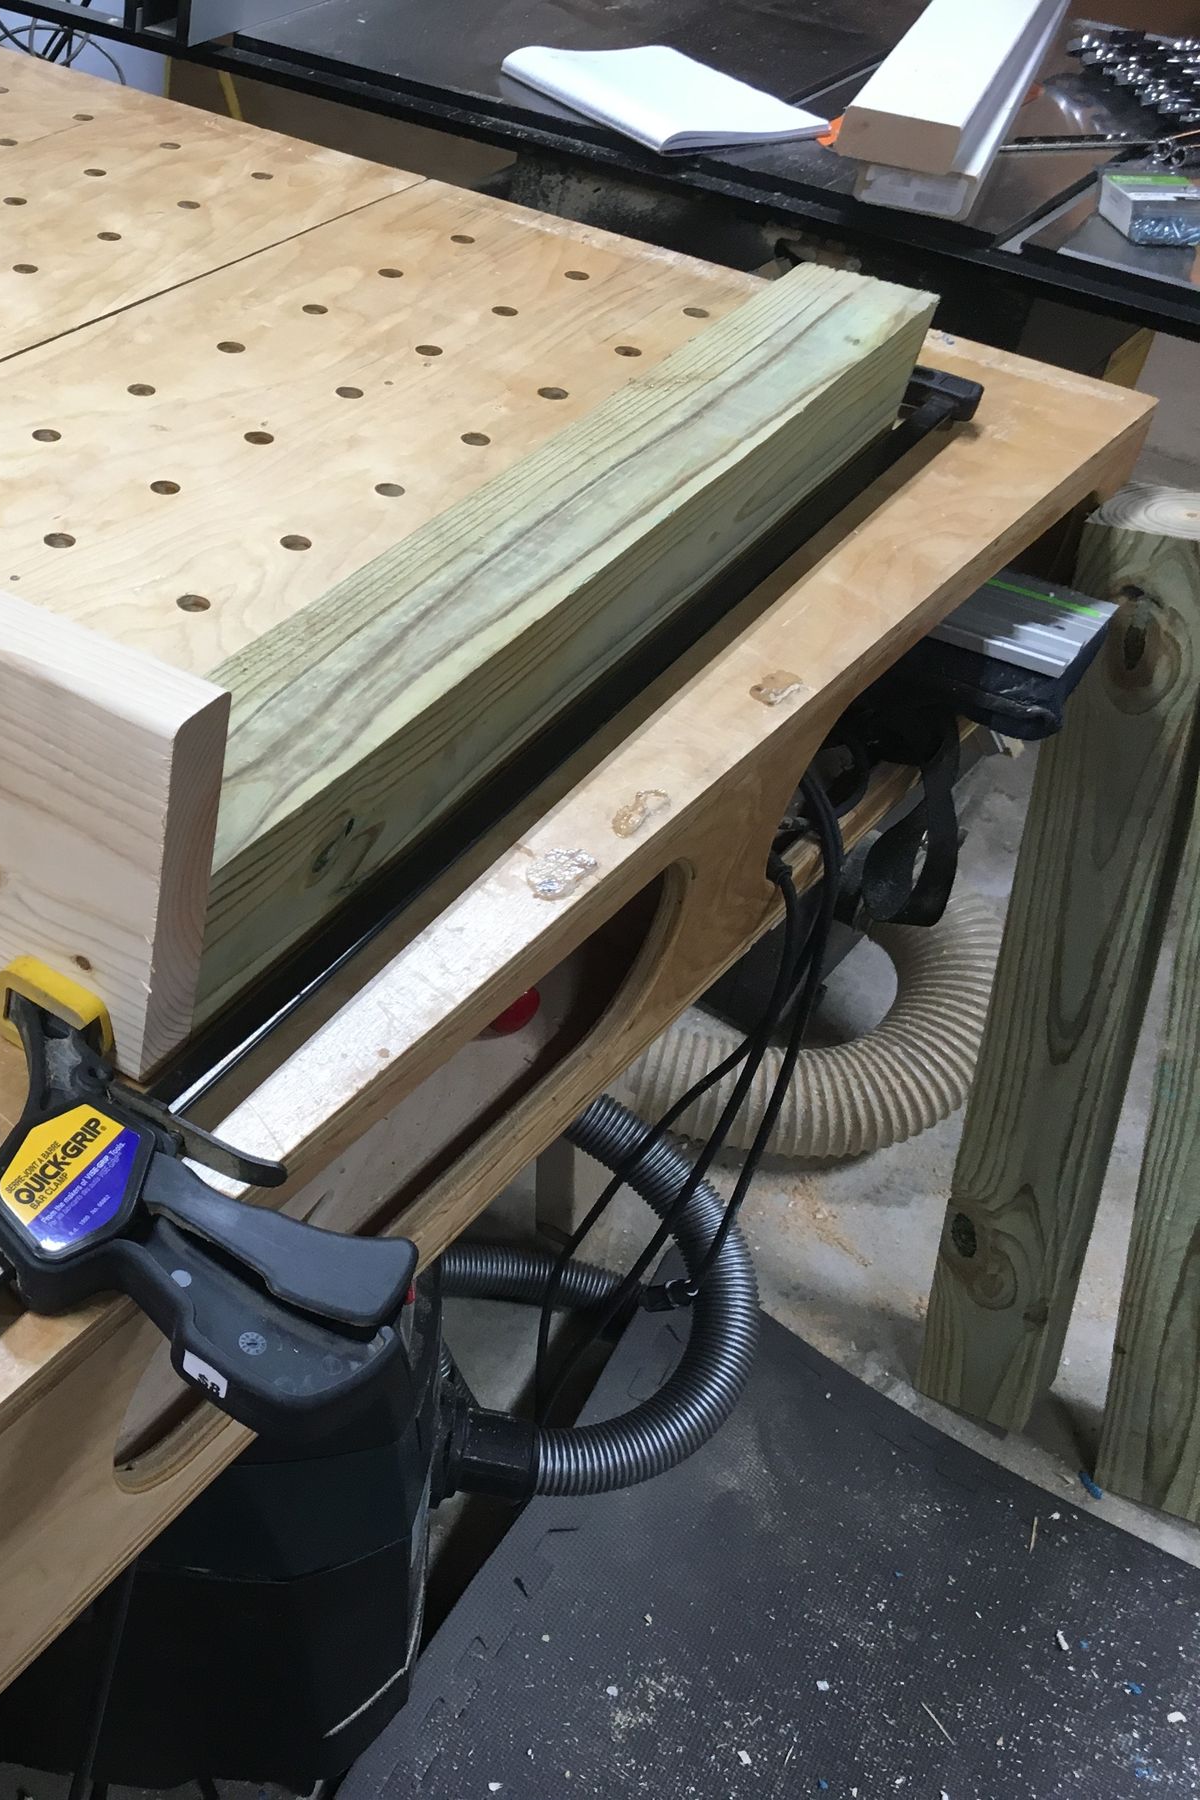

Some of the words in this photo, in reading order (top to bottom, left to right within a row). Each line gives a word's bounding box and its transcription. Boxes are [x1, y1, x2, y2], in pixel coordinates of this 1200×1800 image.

[41, 1140, 62, 1160] BARRE
[30, 1194, 47, 1210] BAR
[45, 1172, 68, 1195] CLAMP
[41, 1210, 57, 1223] From
[54, 1201, 65, 1212] the
[63, 1182, 83, 1203] makers
